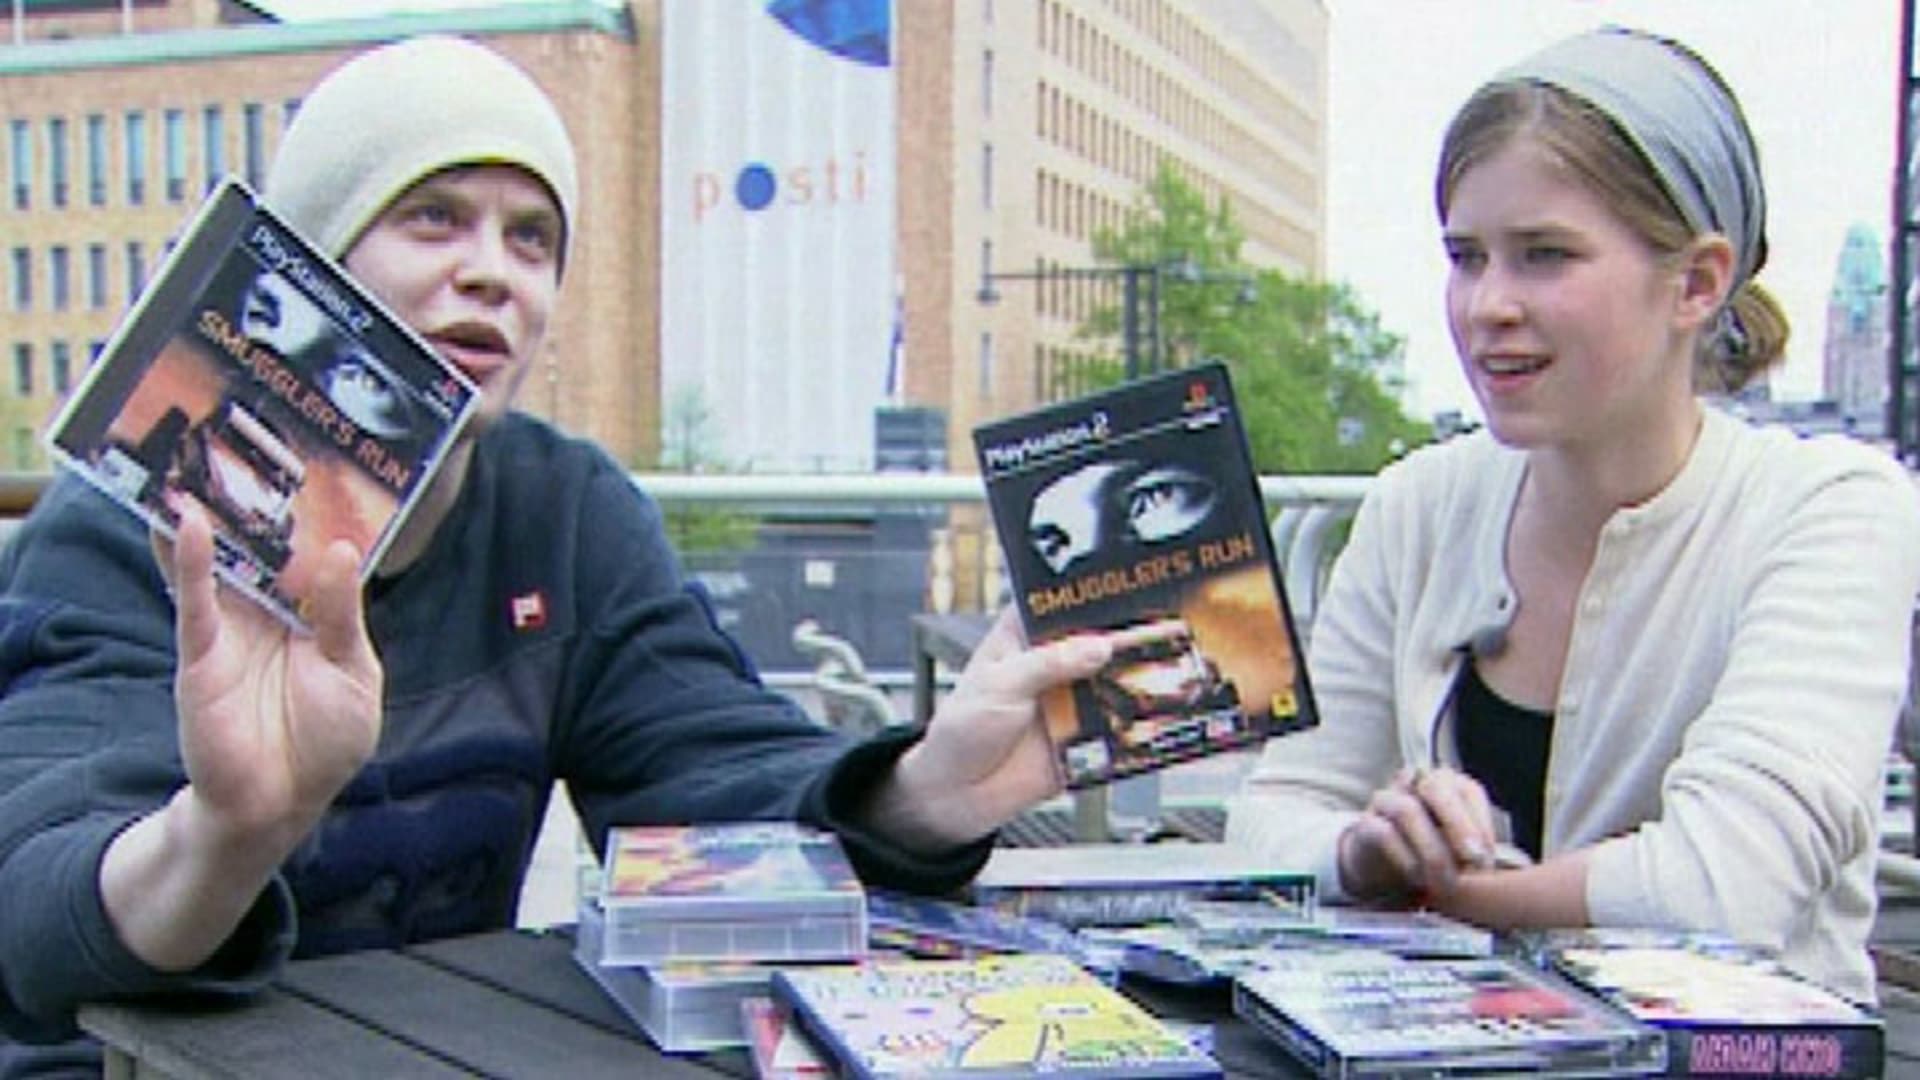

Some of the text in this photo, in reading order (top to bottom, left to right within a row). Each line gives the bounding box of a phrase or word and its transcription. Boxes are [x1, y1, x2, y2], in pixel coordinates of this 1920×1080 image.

[693, 151, 868, 222] posti
[358, 438, 410, 489] RUN
[1199, 533, 1256, 568] RUN
